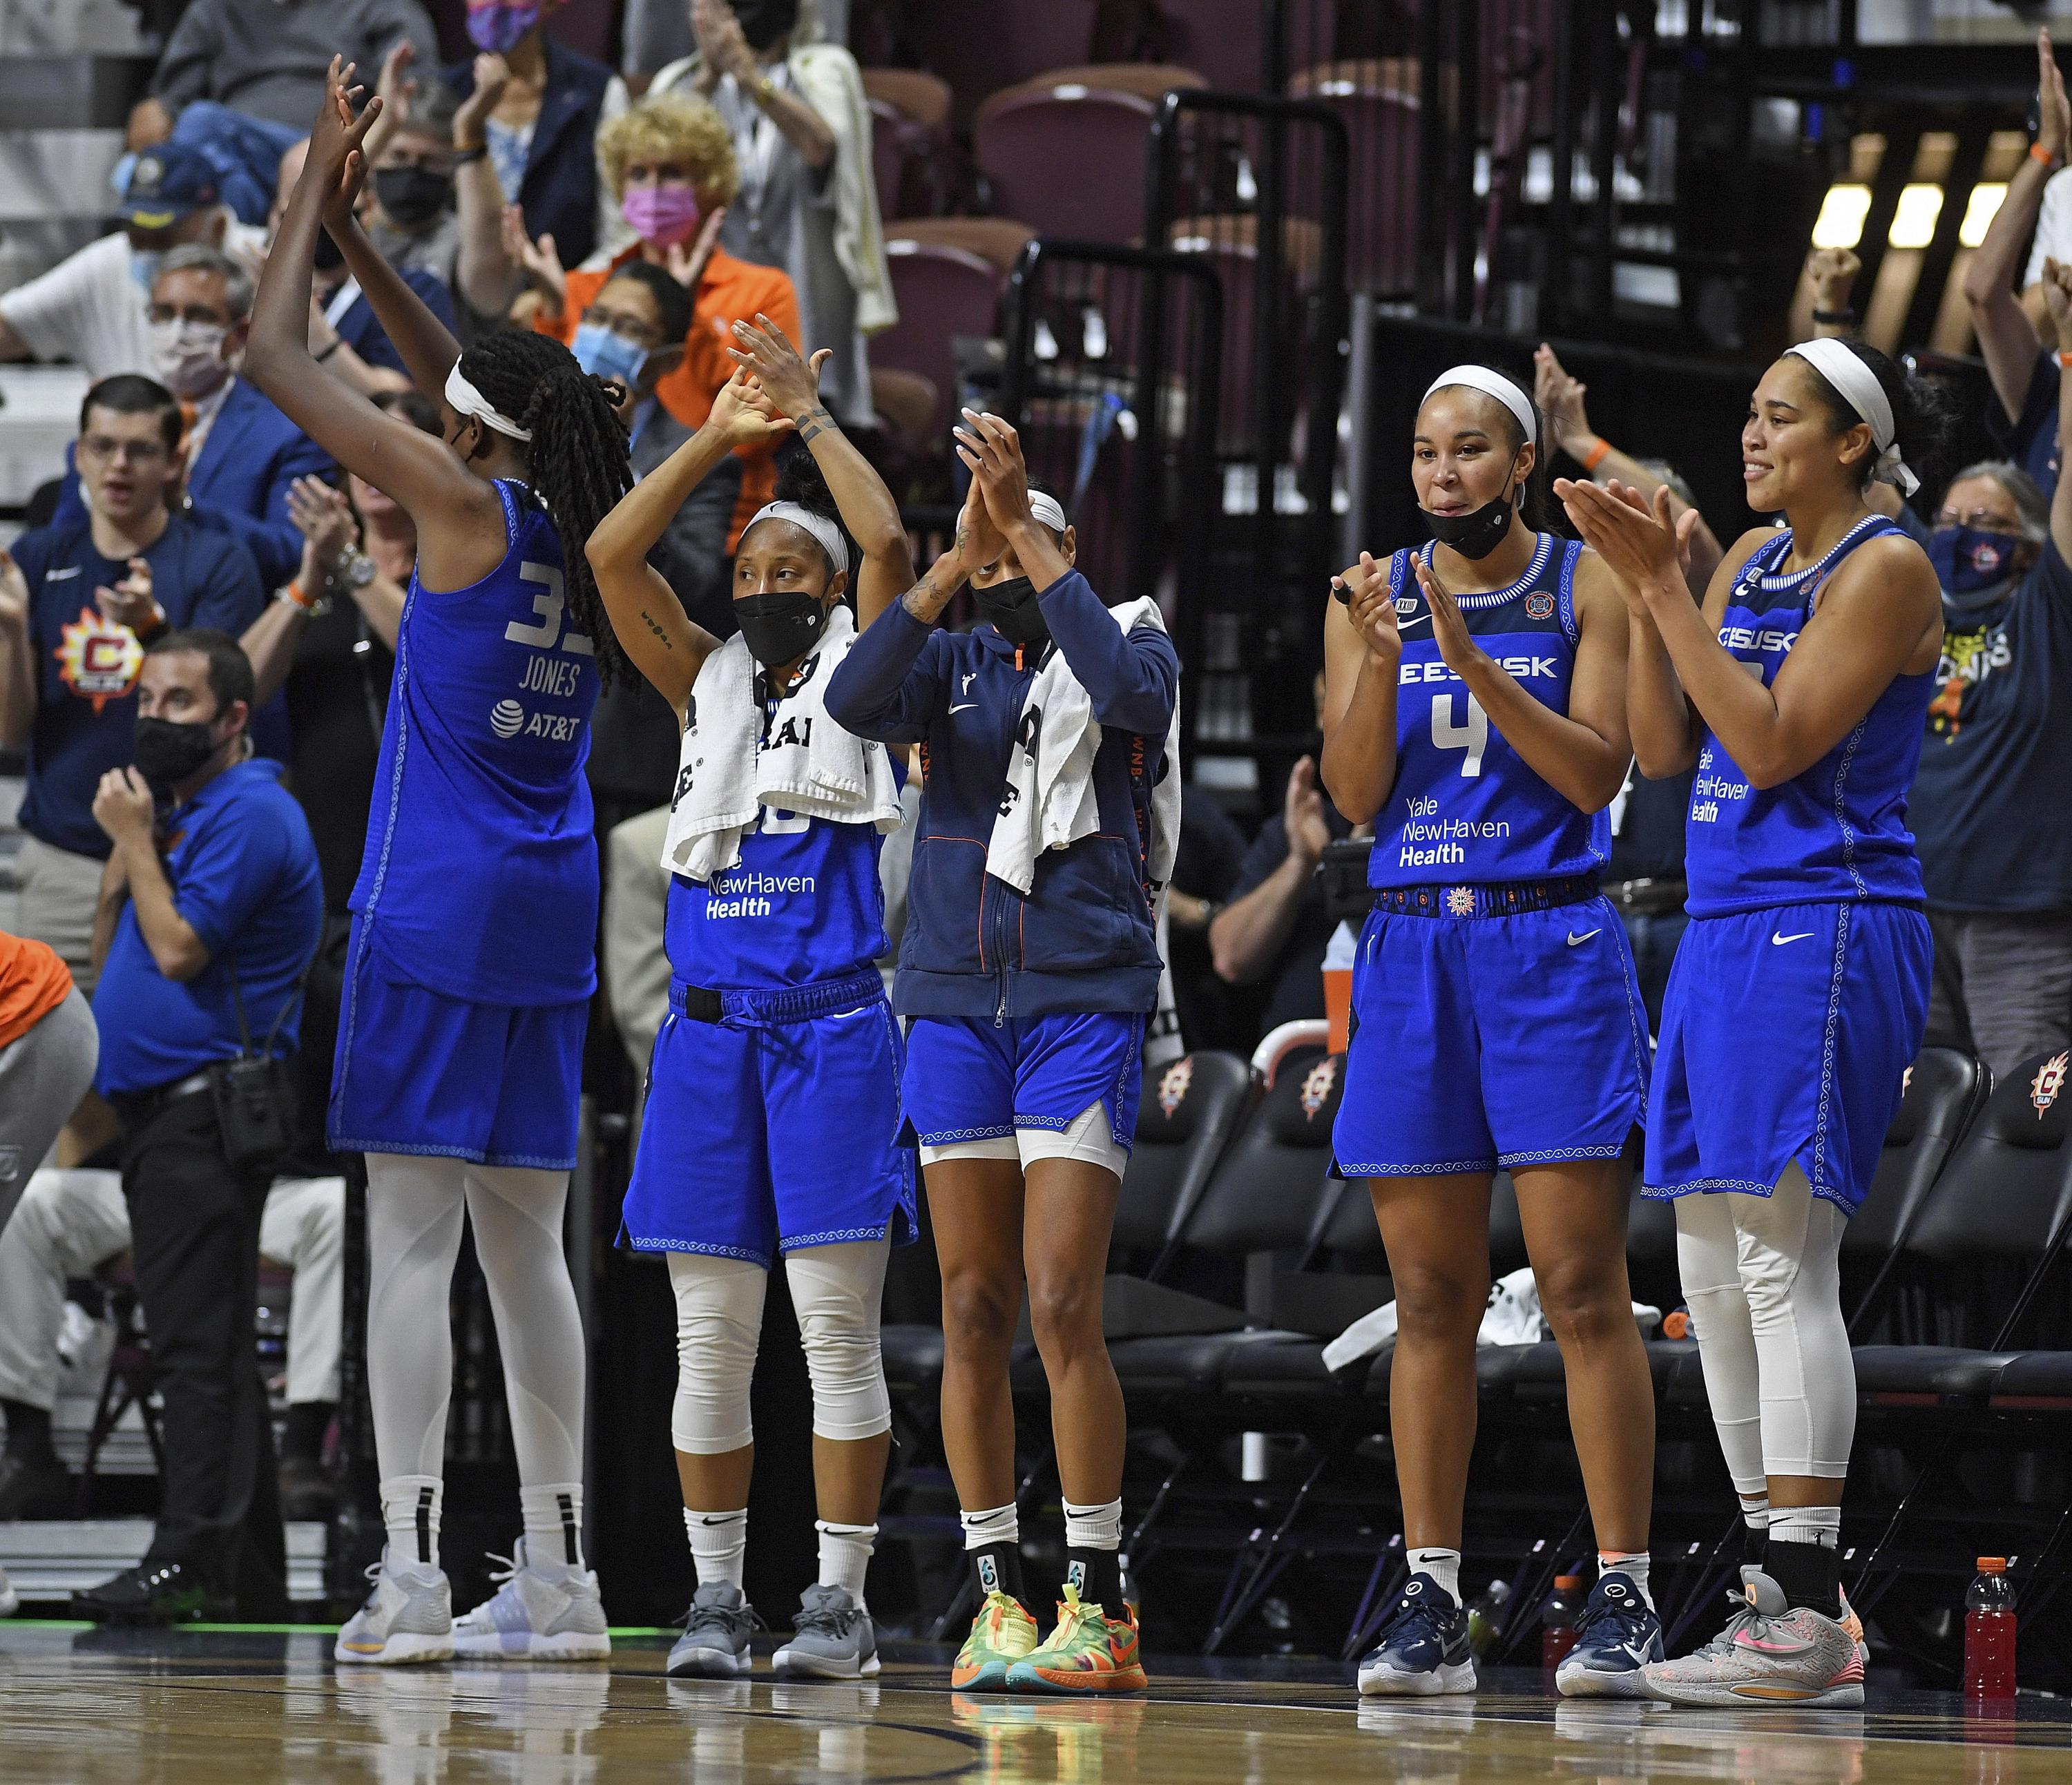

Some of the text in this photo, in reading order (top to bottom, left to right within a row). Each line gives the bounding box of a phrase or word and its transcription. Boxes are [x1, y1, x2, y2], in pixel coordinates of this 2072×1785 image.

[519, 655, 581, 697] JONES
[524, 713, 580, 742] AT&T
[1431, 691, 1488, 778] 4
[1406, 795, 1438, 818] Yale
[1691, 800, 1719, 823] ealth
[1402, 818, 1510, 842] NewHaven
[1399, 842, 1464, 867] Health
[709, 872, 815, 896] NewHaven
[706, 896, 771, 920] Health
[2040, 1071, 2057, 1094] C
[2036, 1096, 2051, 1104] SUN
